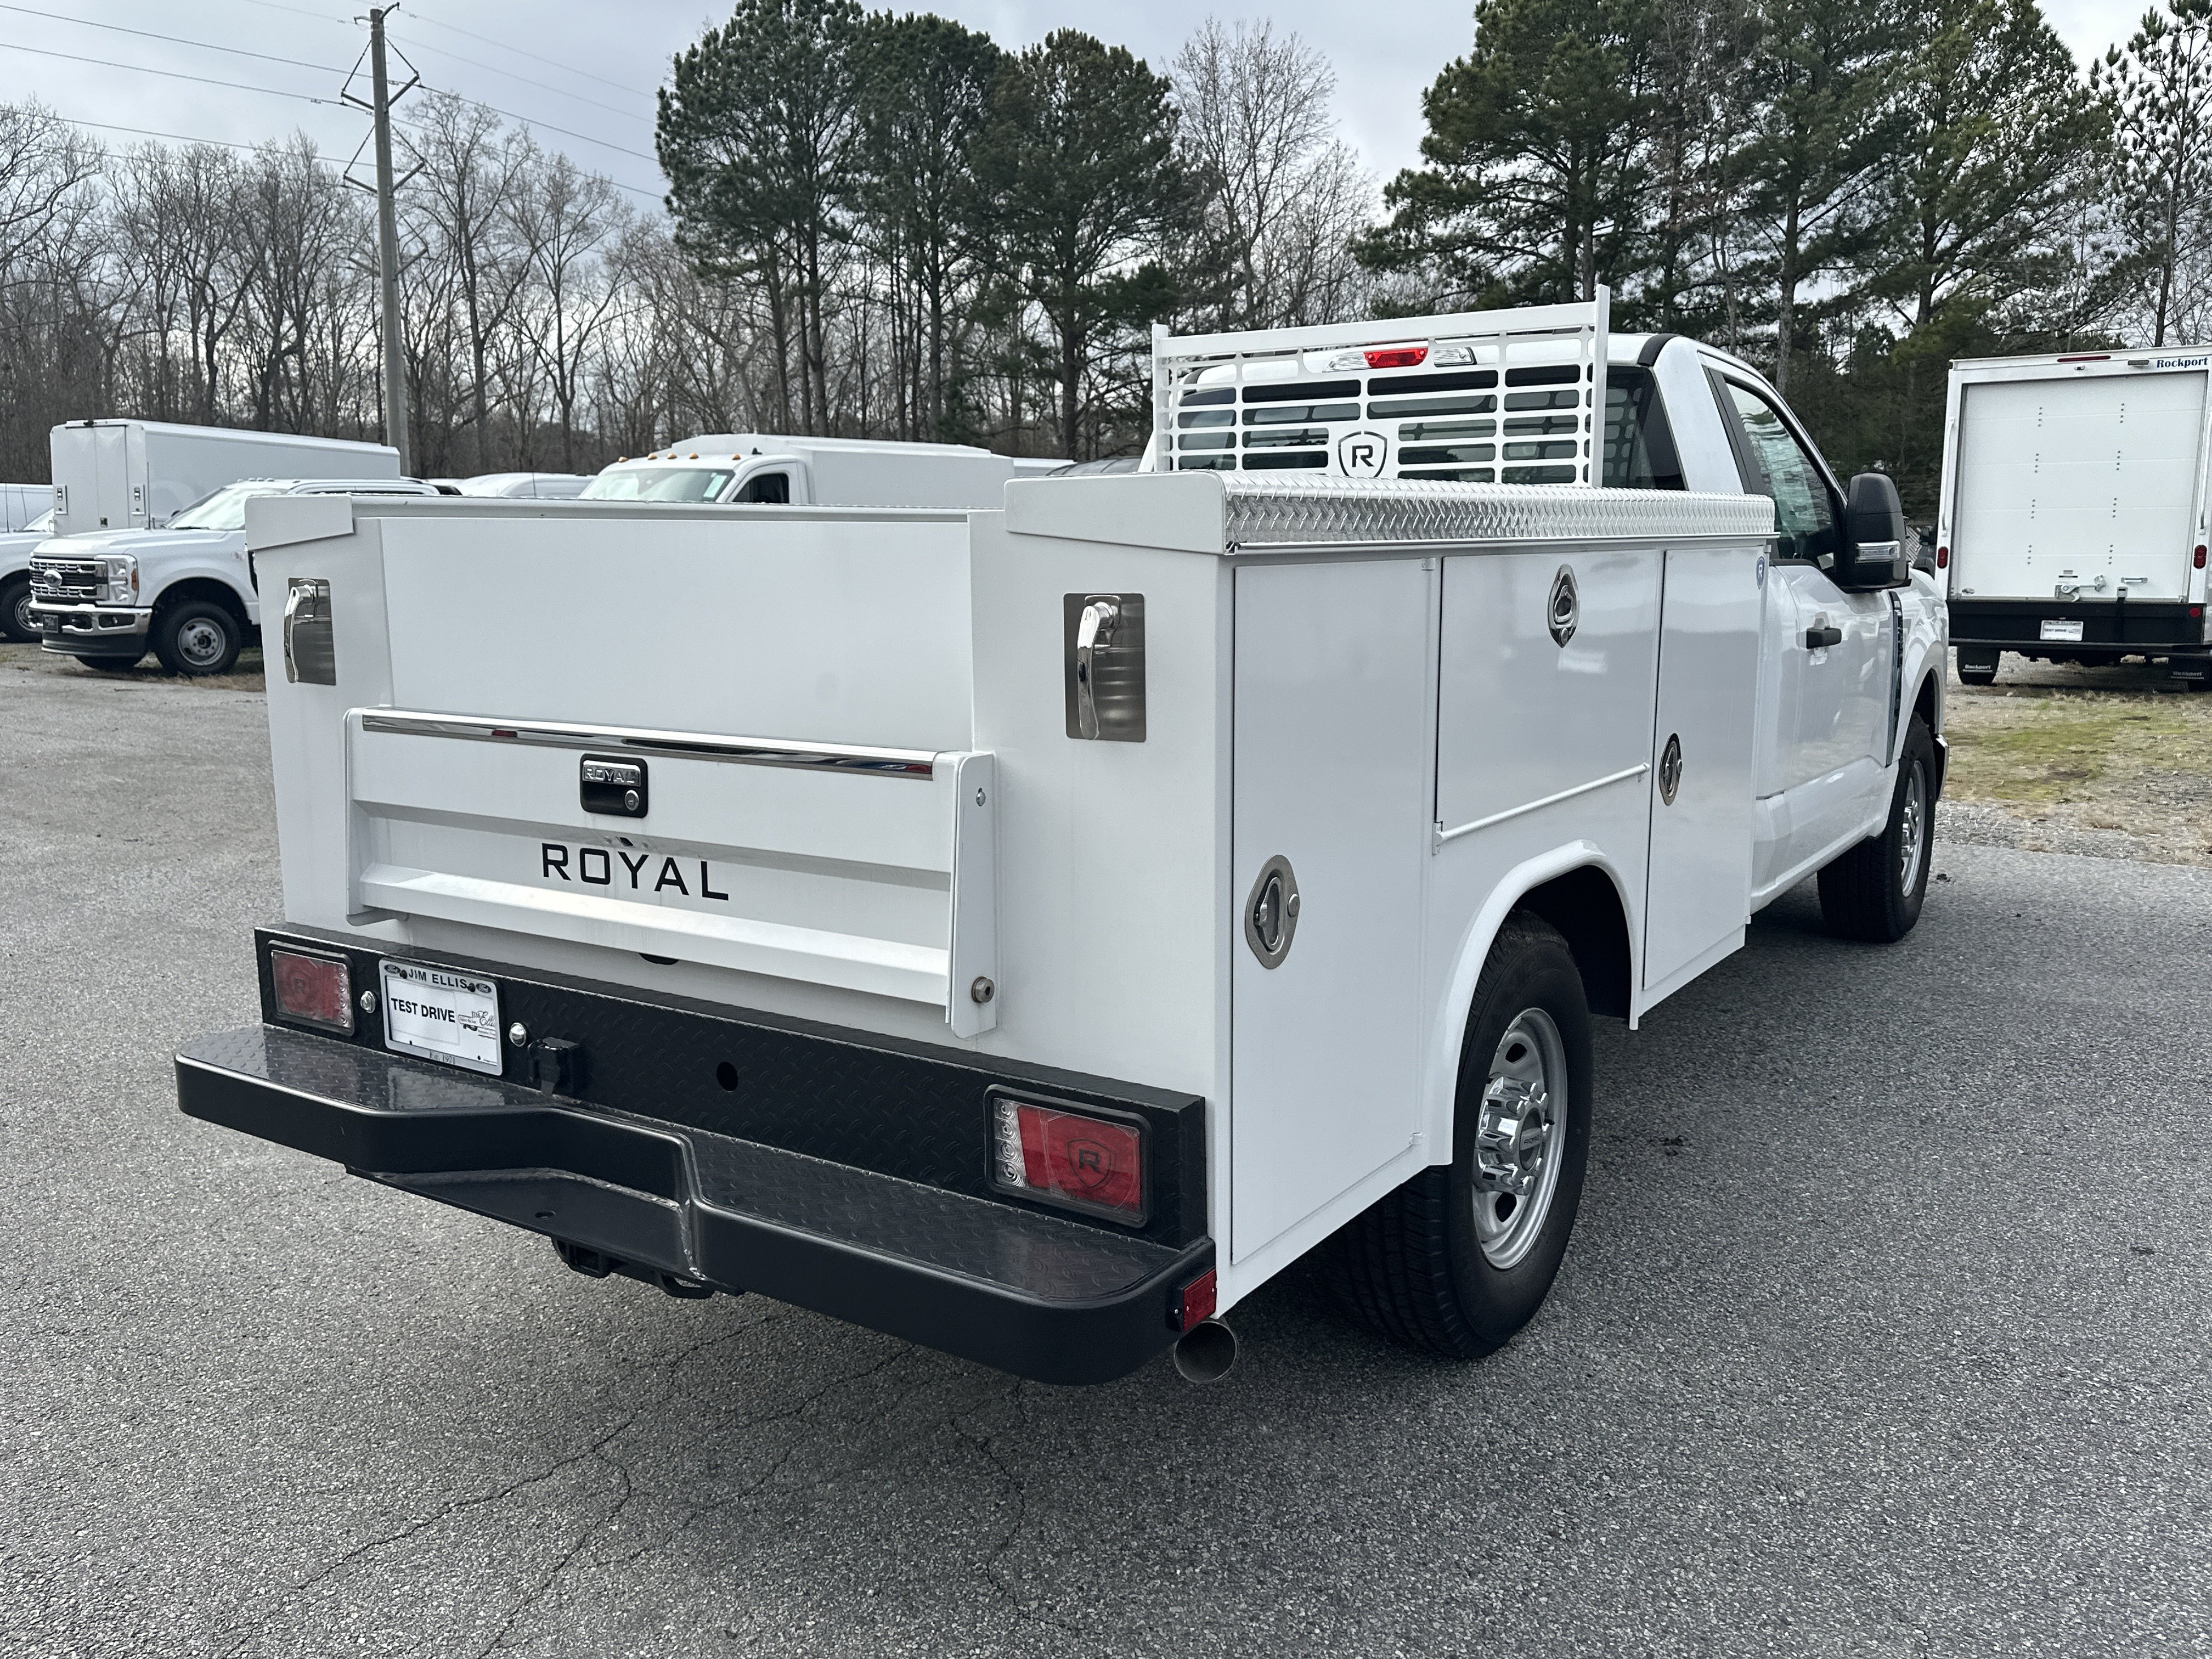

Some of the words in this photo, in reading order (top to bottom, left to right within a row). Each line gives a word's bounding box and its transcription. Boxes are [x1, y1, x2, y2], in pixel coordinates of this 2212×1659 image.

[2157, 357, 2208, 368] Rockport
[1352, 444, 1374, 467] R
[585, 767, 636, 784] ROYAL
[541, 843, 729, 901] ROYAL
[409, 969, 426, 981] JIM
[432, 974, 467, 989] ELLIS
[391, 998, 417, 1015] TEST
[421, 1005, 455, 1023] DRIVE
[443, 1054, 455, 1064] 1971
[1079, 1149, 1102, 1174] R
